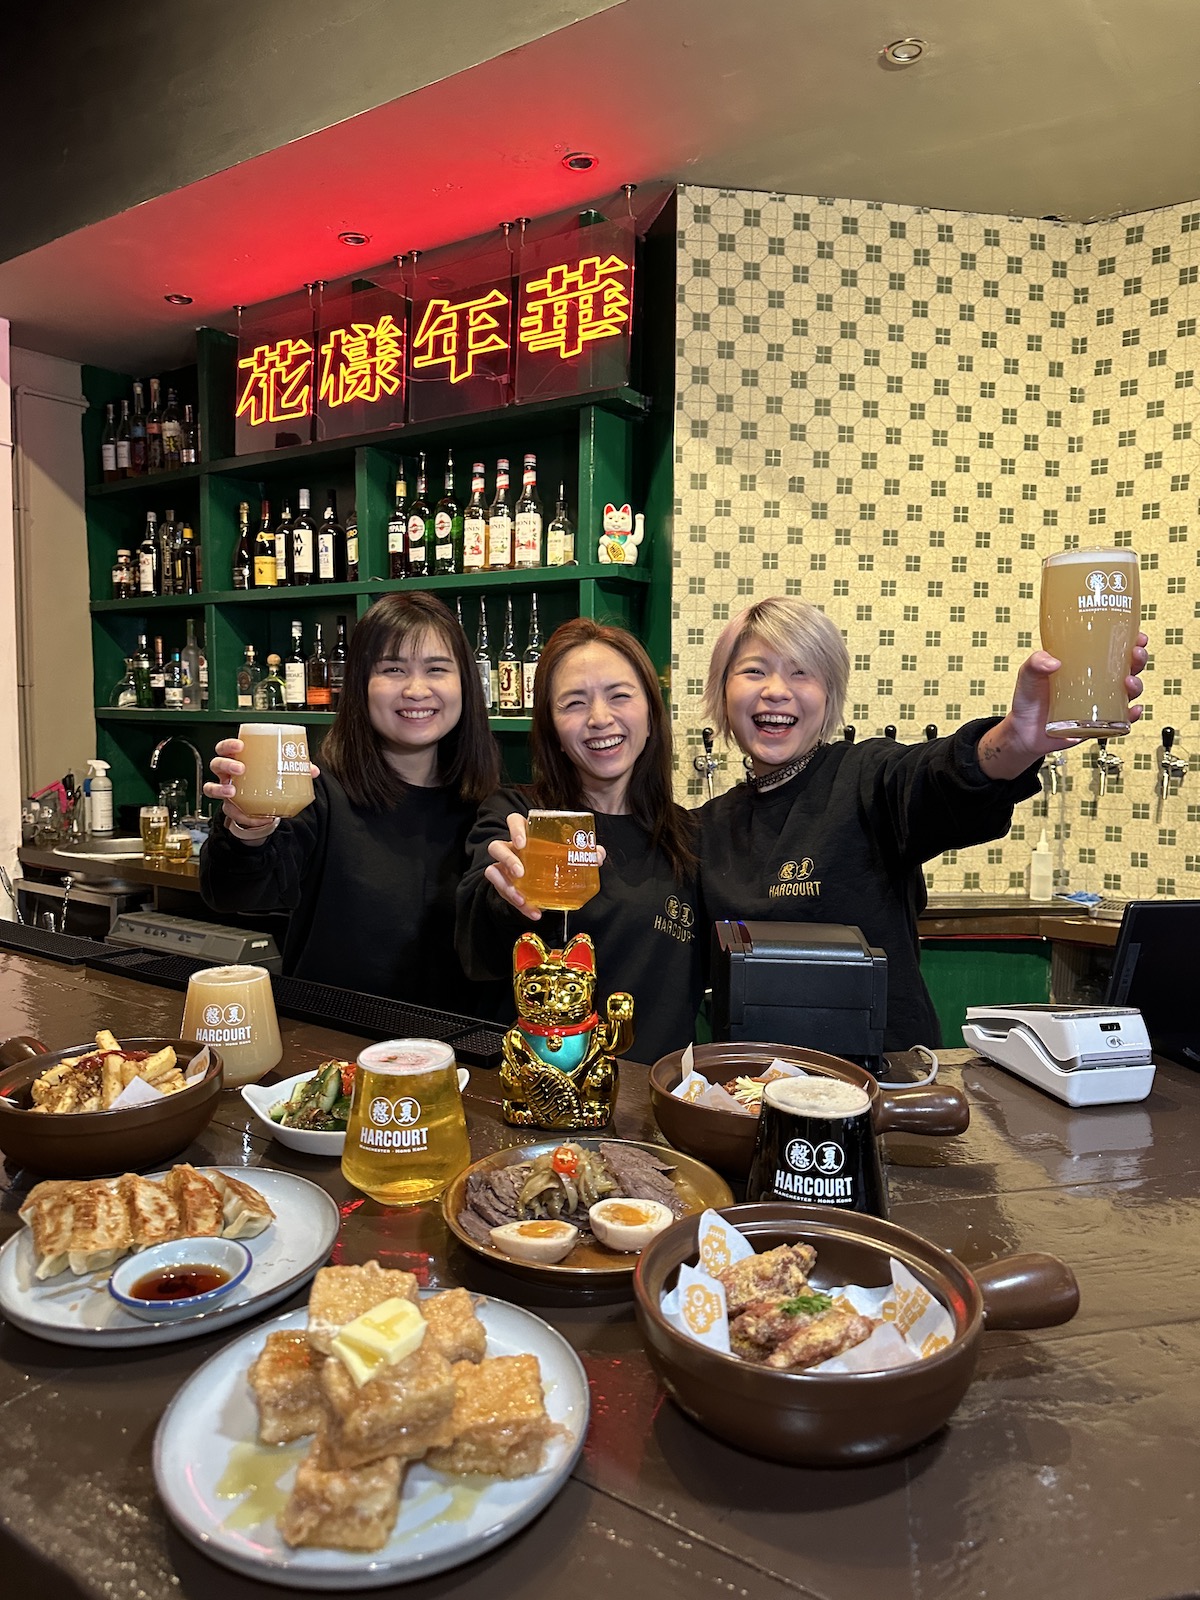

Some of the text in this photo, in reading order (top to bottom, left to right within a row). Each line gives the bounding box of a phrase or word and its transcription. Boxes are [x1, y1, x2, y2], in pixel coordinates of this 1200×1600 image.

[236, 254, 630, 427] 花樣年華
[768, 881, 821, 898] HARCOURT
[196, 1026, 252, 1042] HARCOURT
[360, 1127, 429, 1148] HARCOURT
[775, 1169, 853, 1197] HARCOURT
[773, 1188, 812, 1203] MANCHESTER
